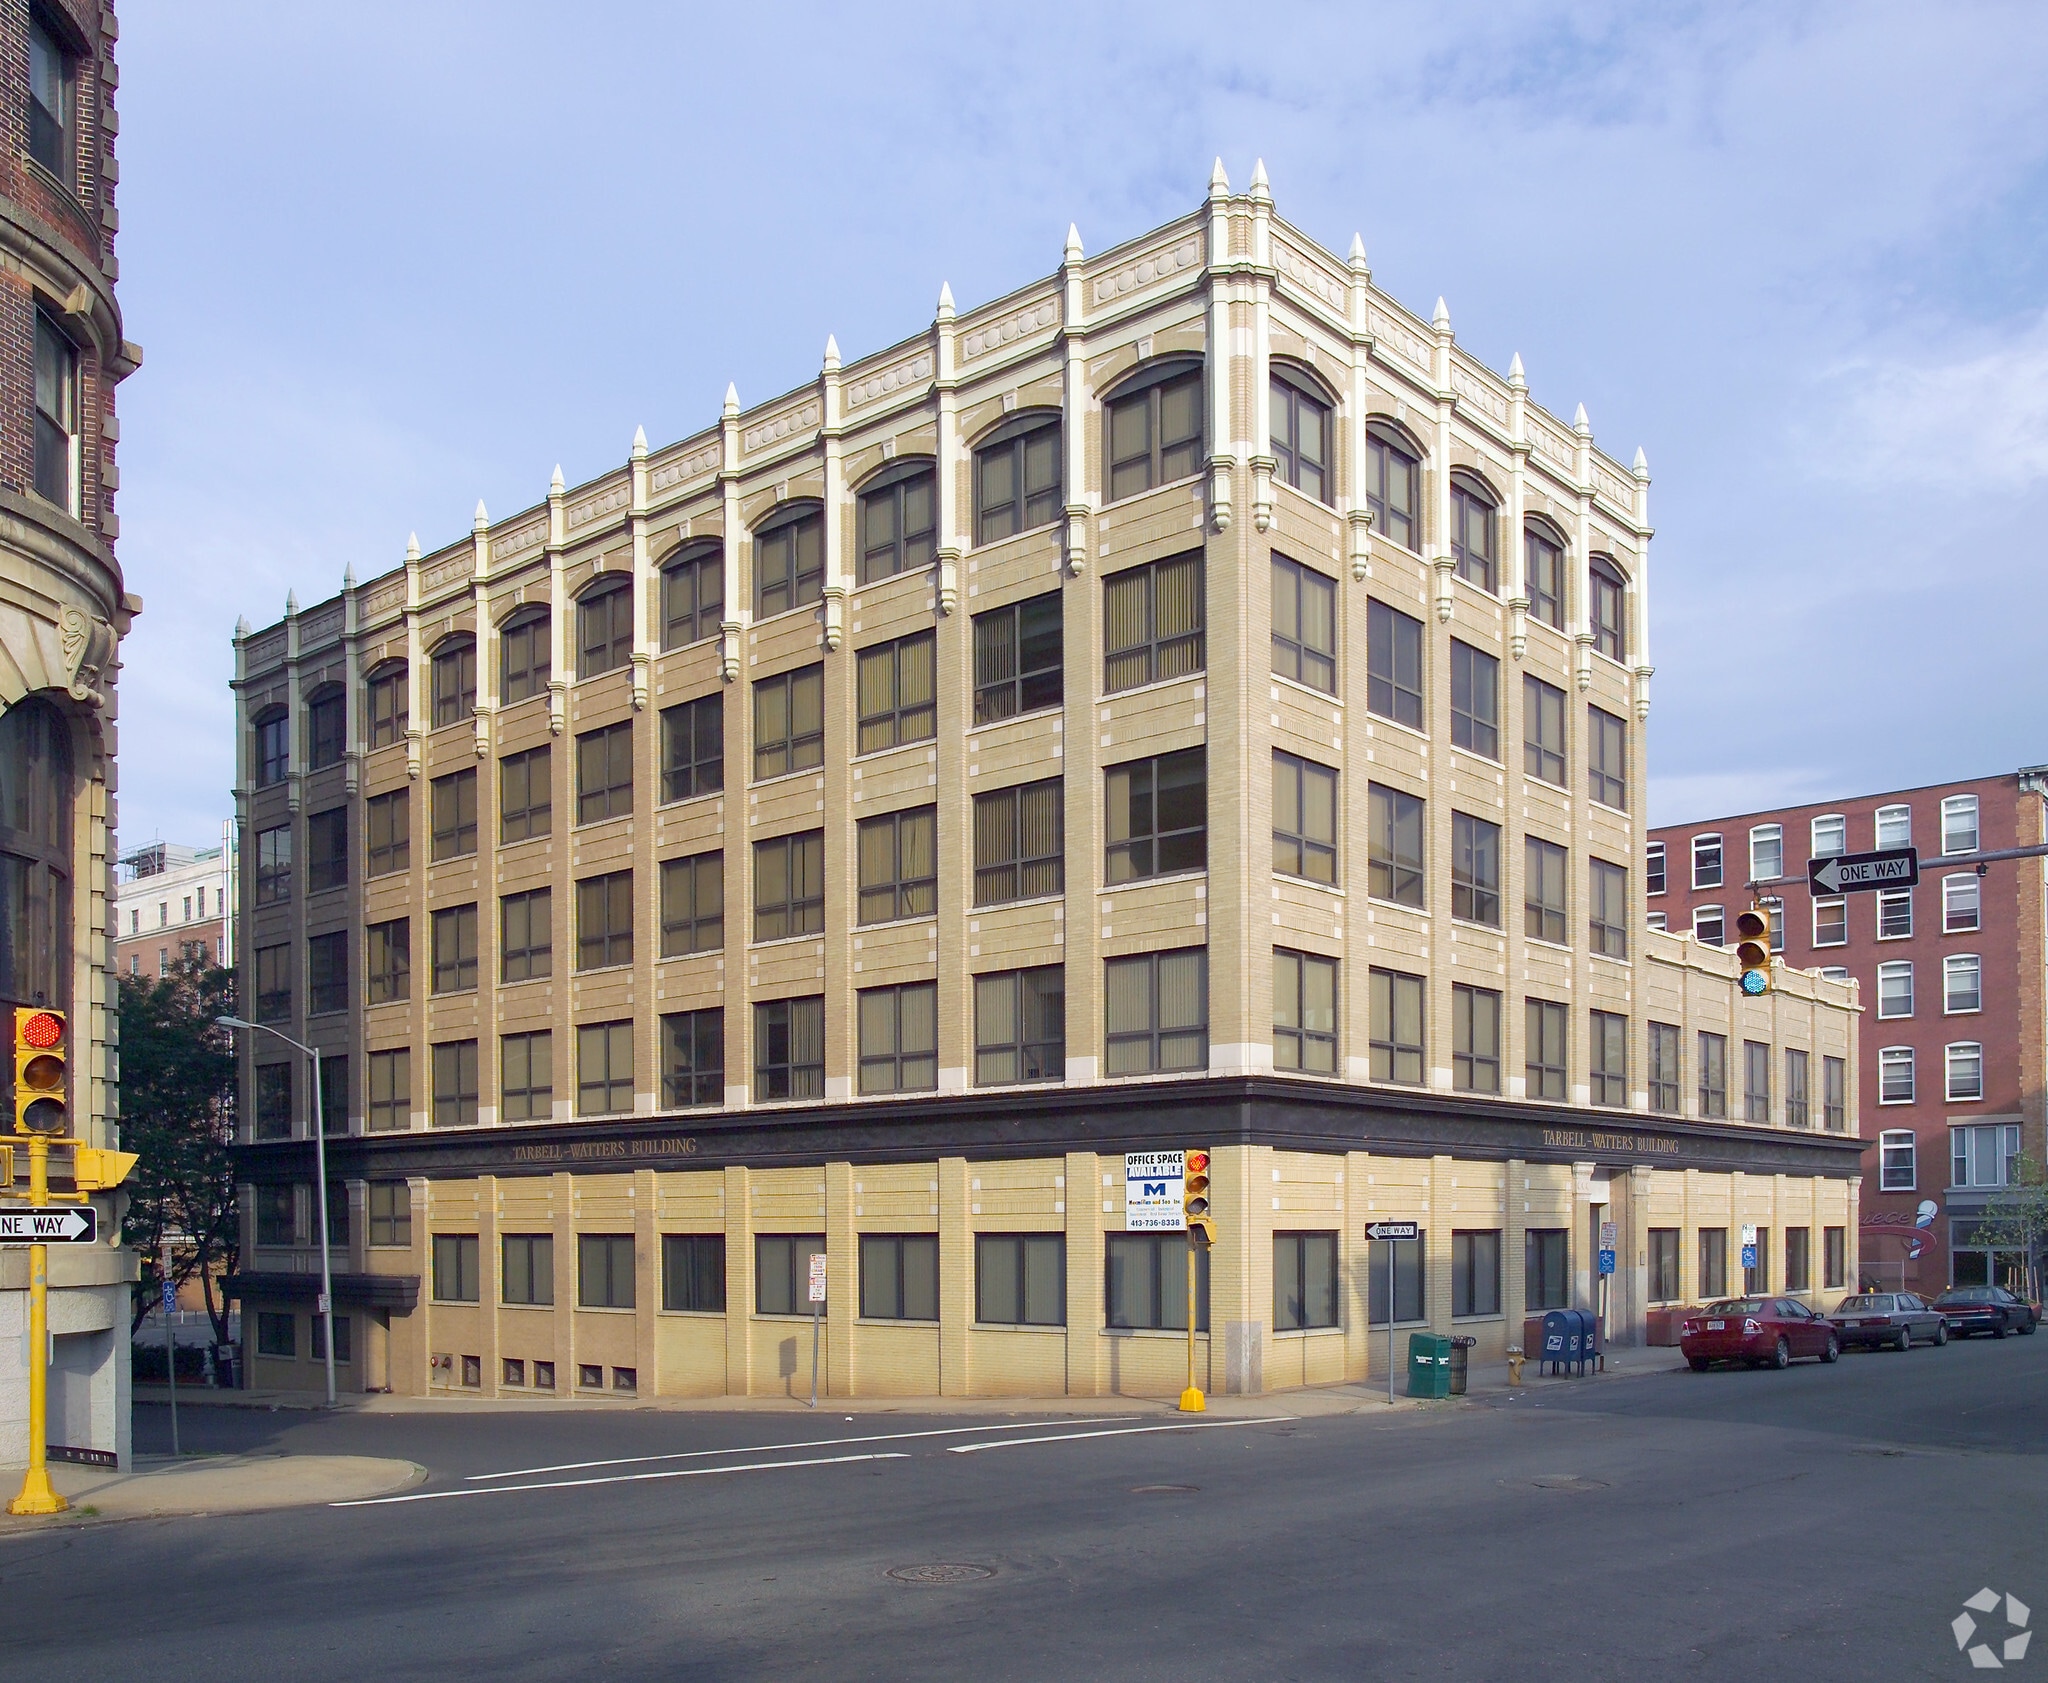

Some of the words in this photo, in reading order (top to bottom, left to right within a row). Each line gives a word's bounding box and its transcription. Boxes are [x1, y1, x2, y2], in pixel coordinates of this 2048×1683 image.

[1840, 865, 1870, 881] ONE
[1874, 860, 1905, 878] WAY
[631, 1137, 697, 1156] BUILDING
[1637, 1137, 1679, 1154] BUILDING
[1127, 1154, 1155, 1165] OFFICE
[1157, 1153, 1183, 1164] SPACE
[1127, 1166, 1182, 1177] AVAILABLE
[1144, 1183, 1166, 1196] M
[0, 1217, 23, 1234] NE
[33, 1217, 65, 1234] WAY
[1376, 1227, 1391, 1235] ONE
